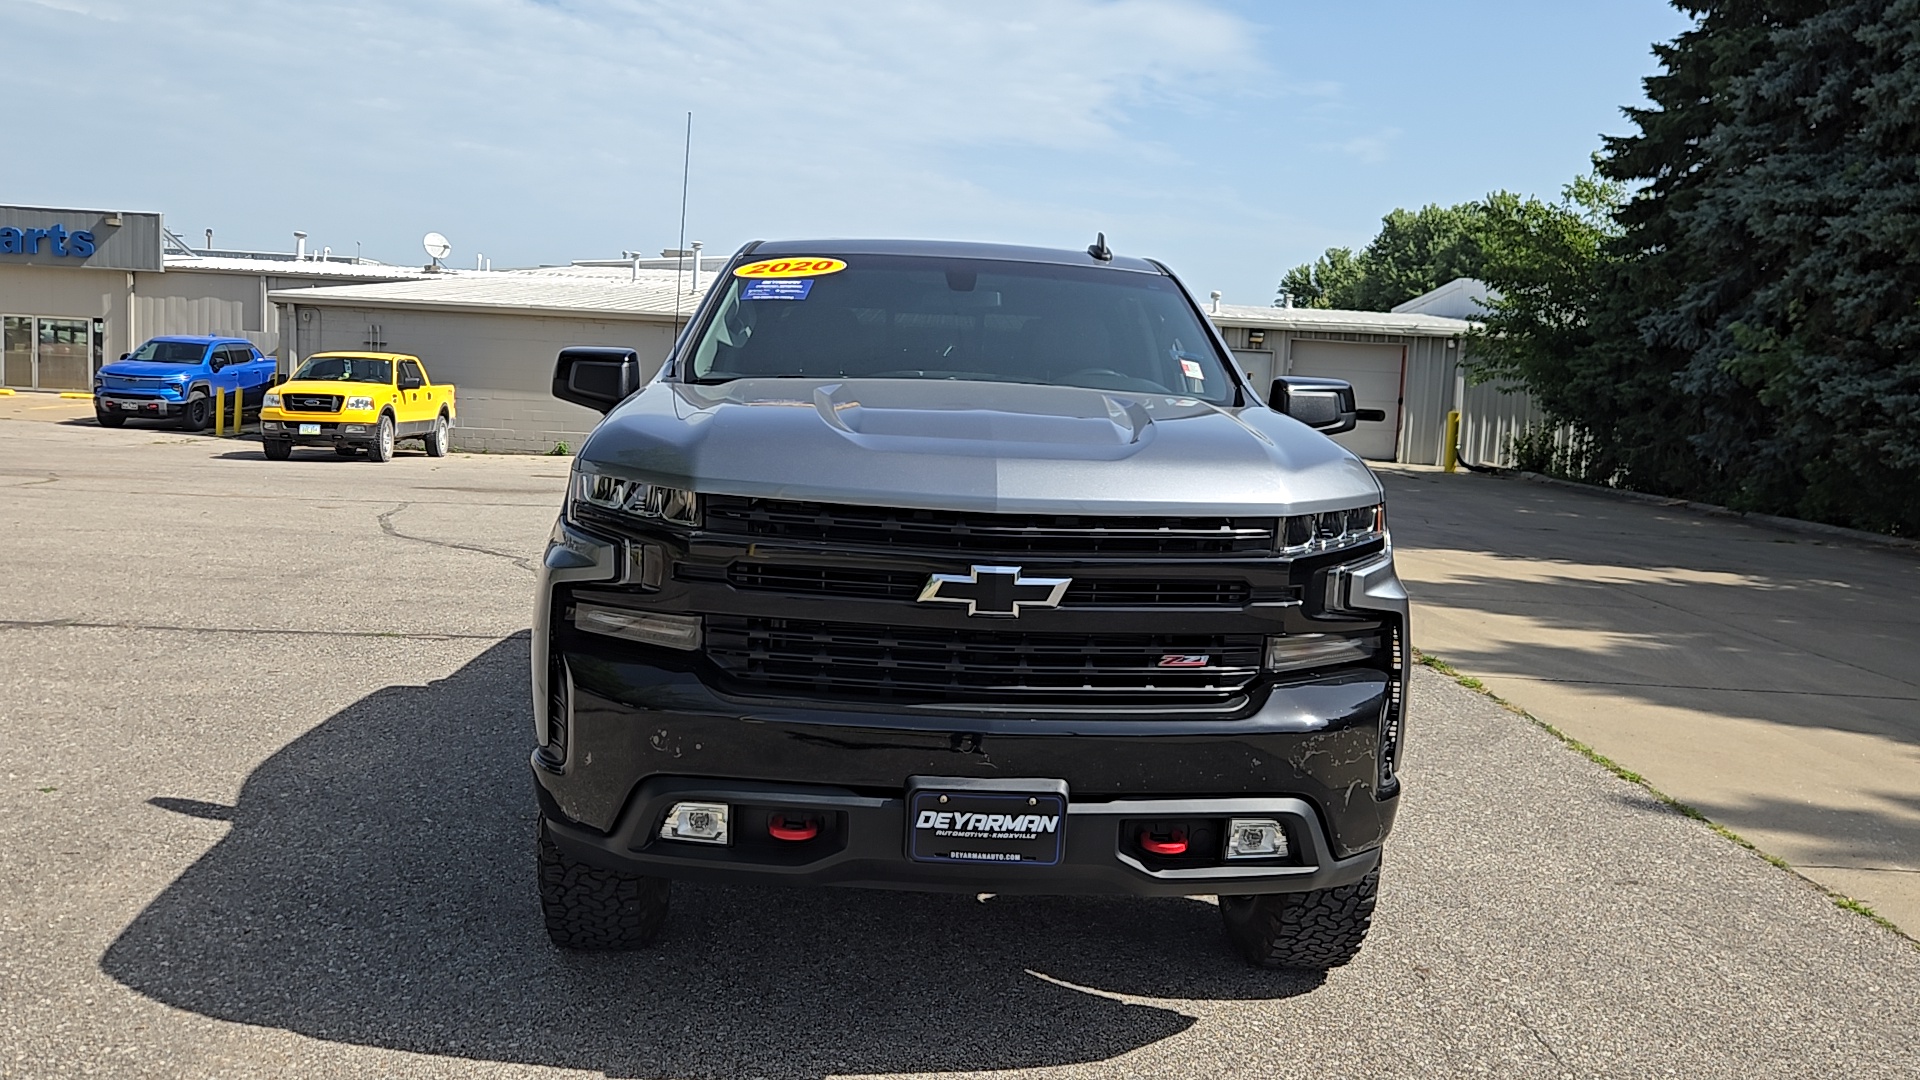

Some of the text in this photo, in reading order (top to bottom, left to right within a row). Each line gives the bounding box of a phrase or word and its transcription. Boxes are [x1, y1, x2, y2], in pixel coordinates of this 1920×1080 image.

[0, 224, 94, 258] arts
[745, 261, 834, 275] 2020
[916, 810, 1060, 833] DEYARMAN
[950, 851, 1021, 861] DEYARMANAUTO.COM
